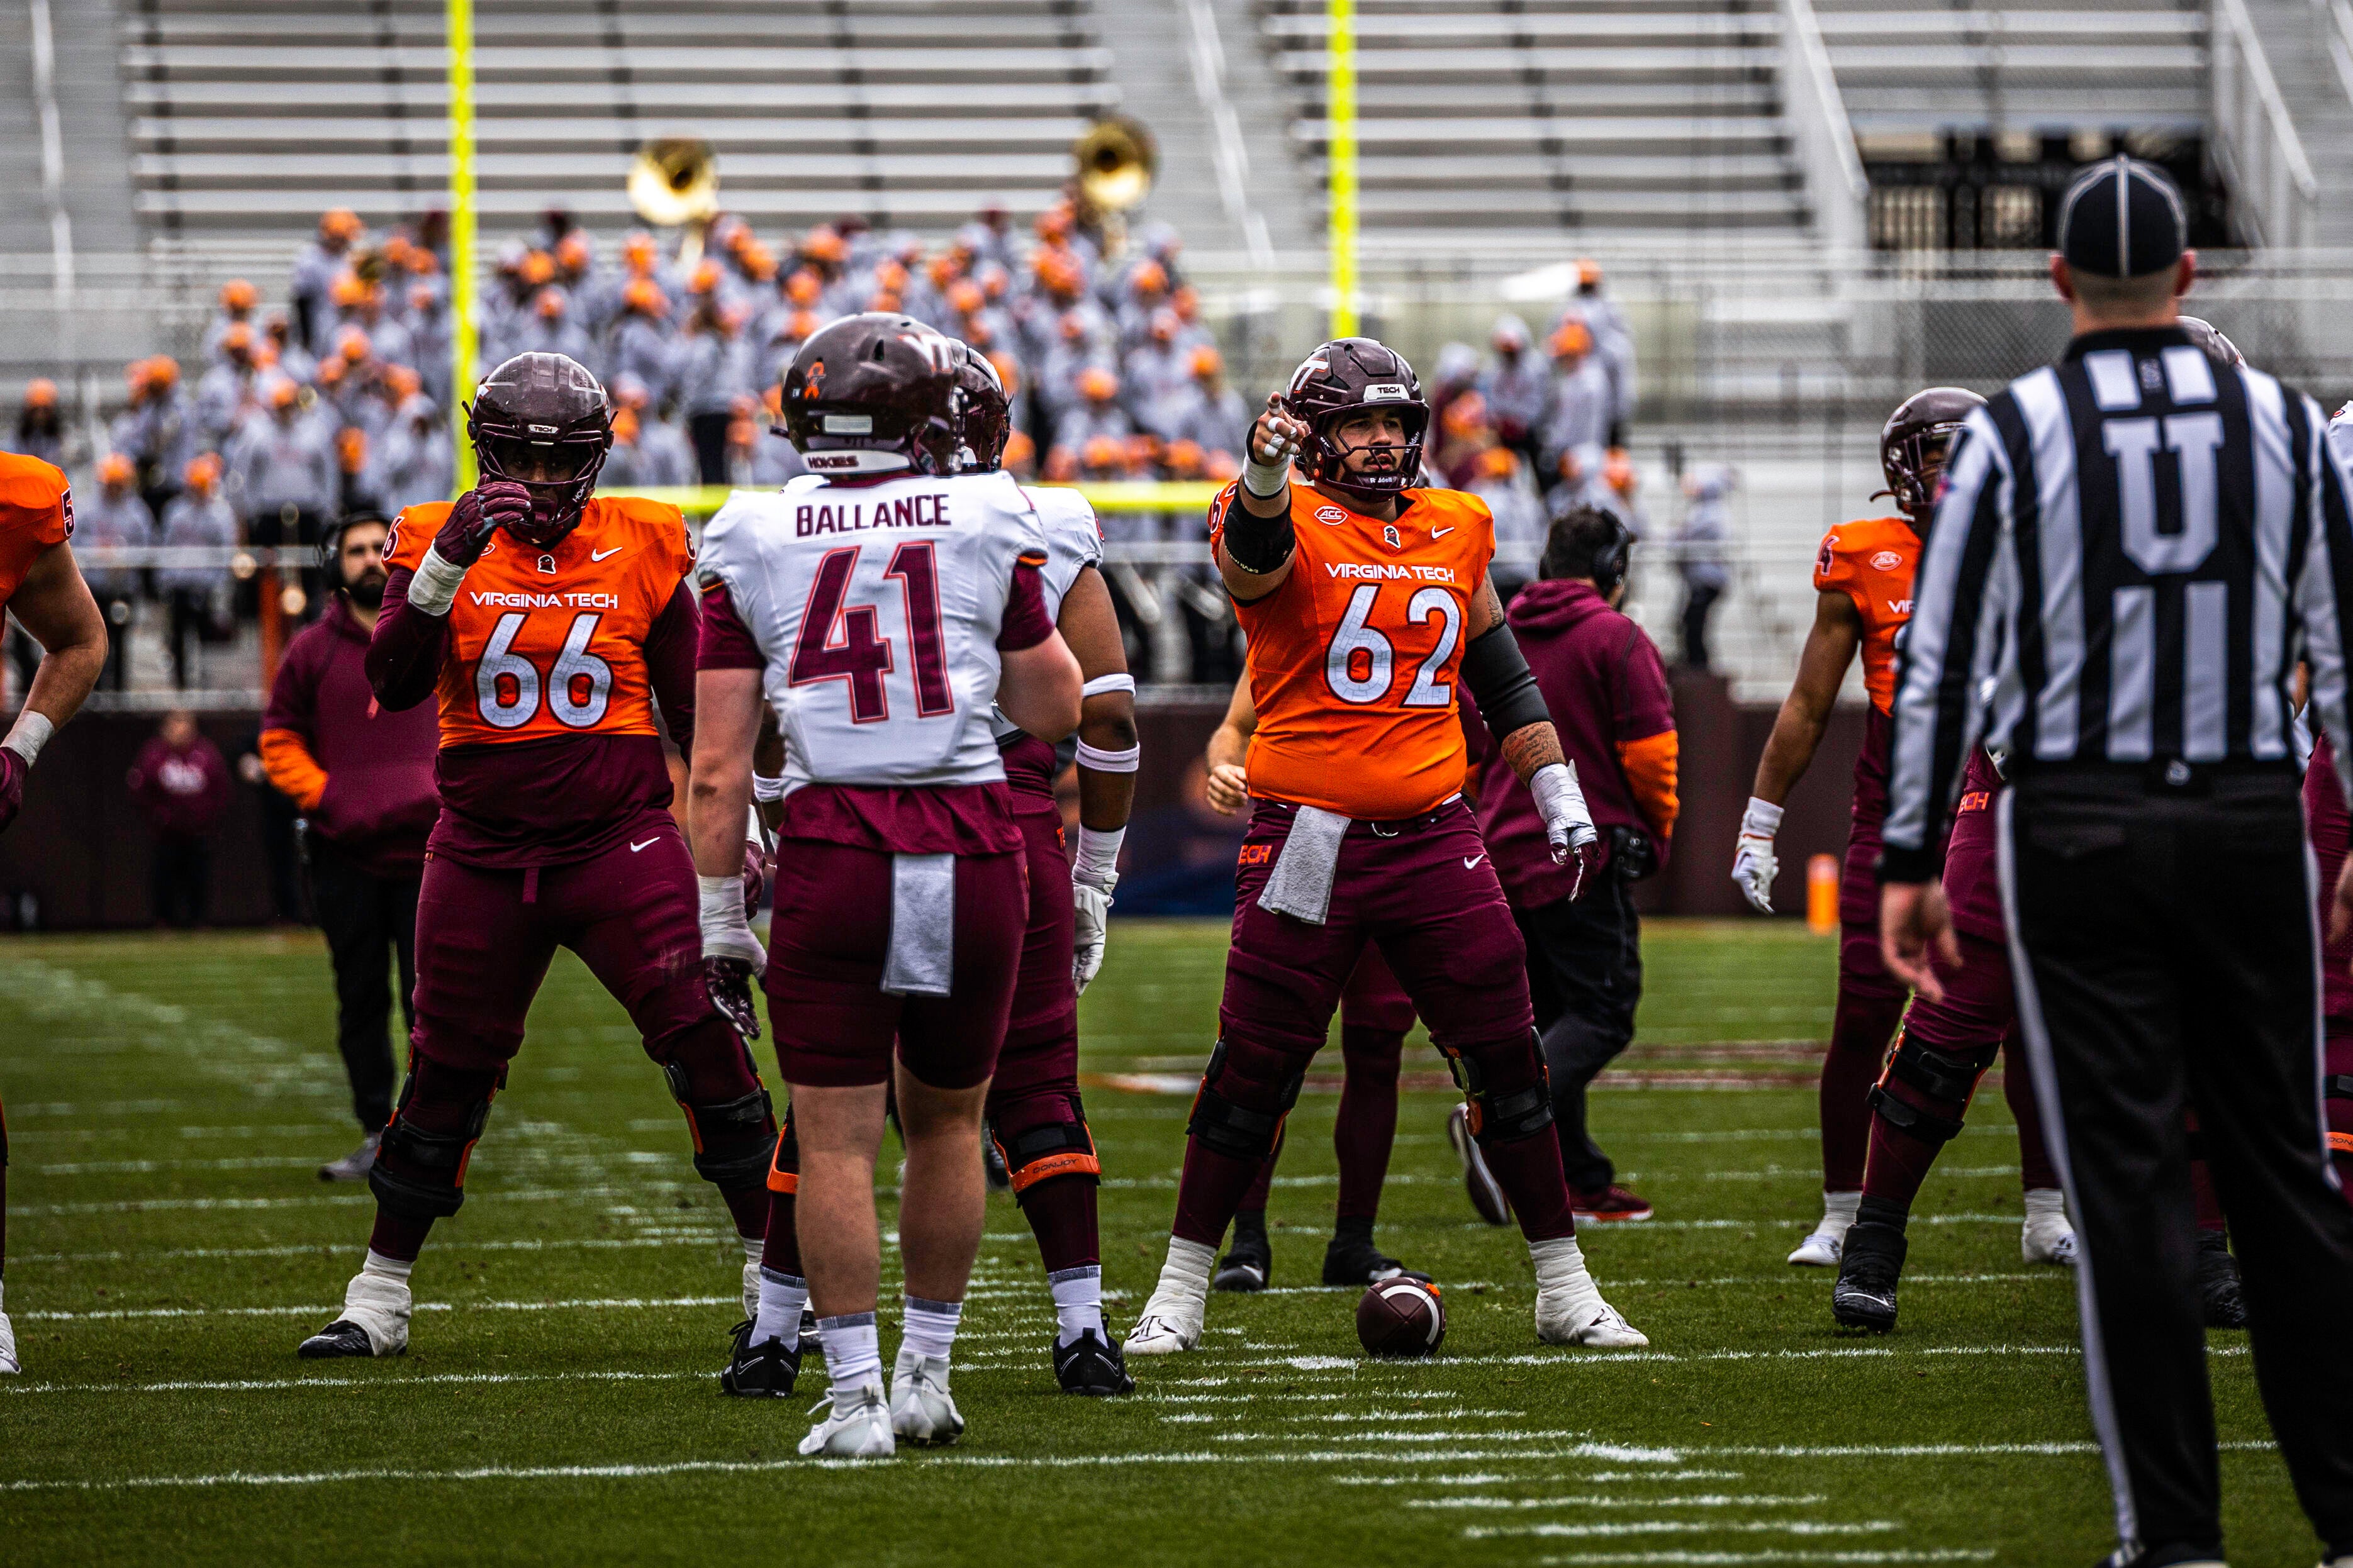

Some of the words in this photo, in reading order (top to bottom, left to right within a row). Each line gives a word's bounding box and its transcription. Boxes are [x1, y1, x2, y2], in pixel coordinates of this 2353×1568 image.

[808, 455, 859, 469] HOKIES
[2102, 410, 2225, 575] U
[795, 493, 952, 538] BALLANCE
[1324, 562, 1412, 579] VIRGINIA
[1411, 565, 1455, 583] TECH
[469, 591, 563, 608] VIRGINIA
[564, 593, 618, 609] TECH
[788, 539, 955, 725] 41
[1324, 582, 1462, 708] 62
[474, 610, 615, 730] 66
[1032, 1158, 1078, 1174] DONJOY
